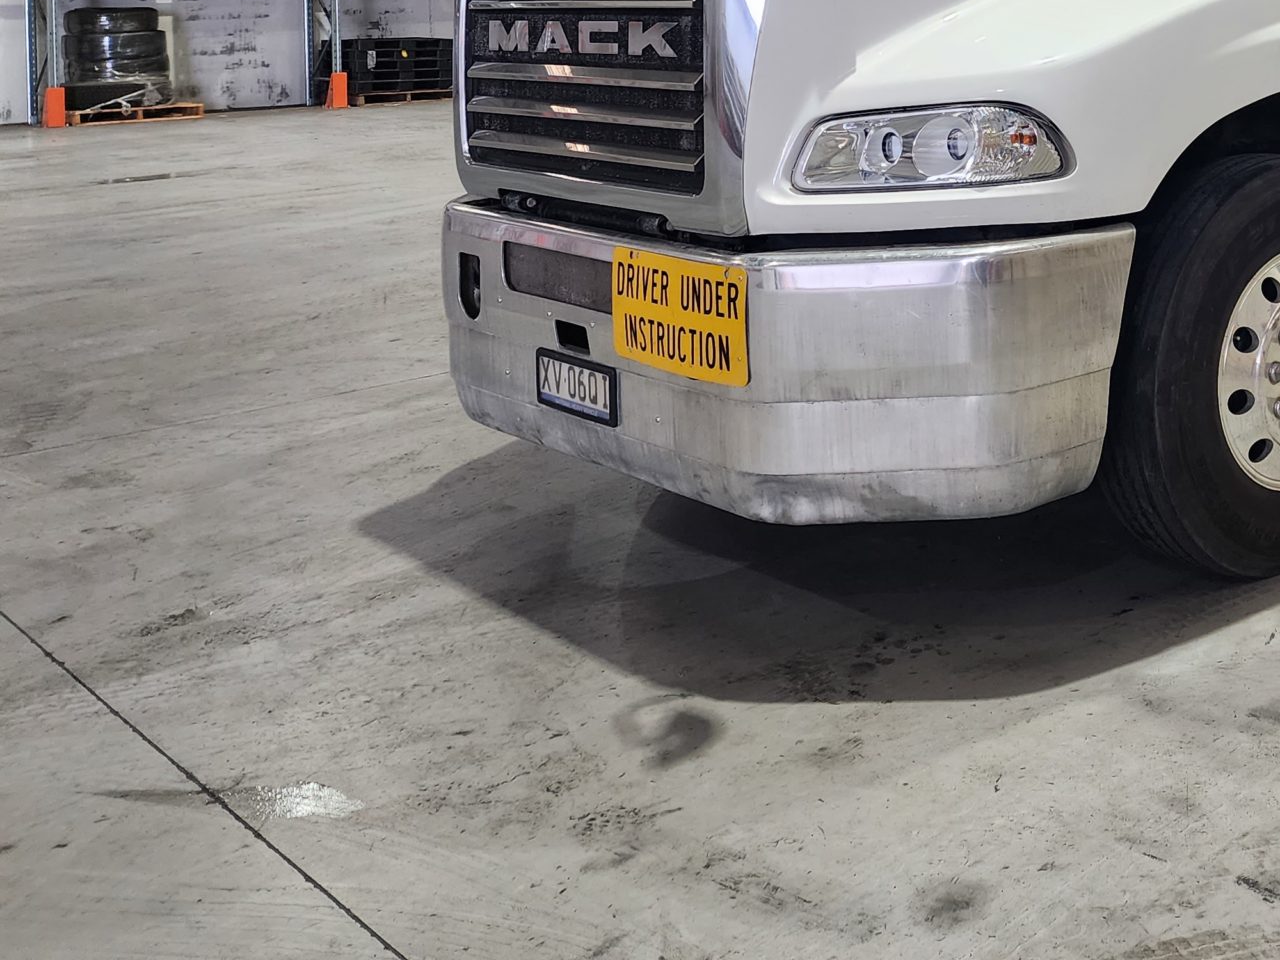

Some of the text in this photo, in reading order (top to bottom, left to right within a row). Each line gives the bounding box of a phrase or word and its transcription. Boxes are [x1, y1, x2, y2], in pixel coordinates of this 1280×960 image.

[488, 20, 679, 57] MACK
[617, 261, 739, 320] DRIVER UNDER
[624, 313, 731, 372] INSTRUCTION
